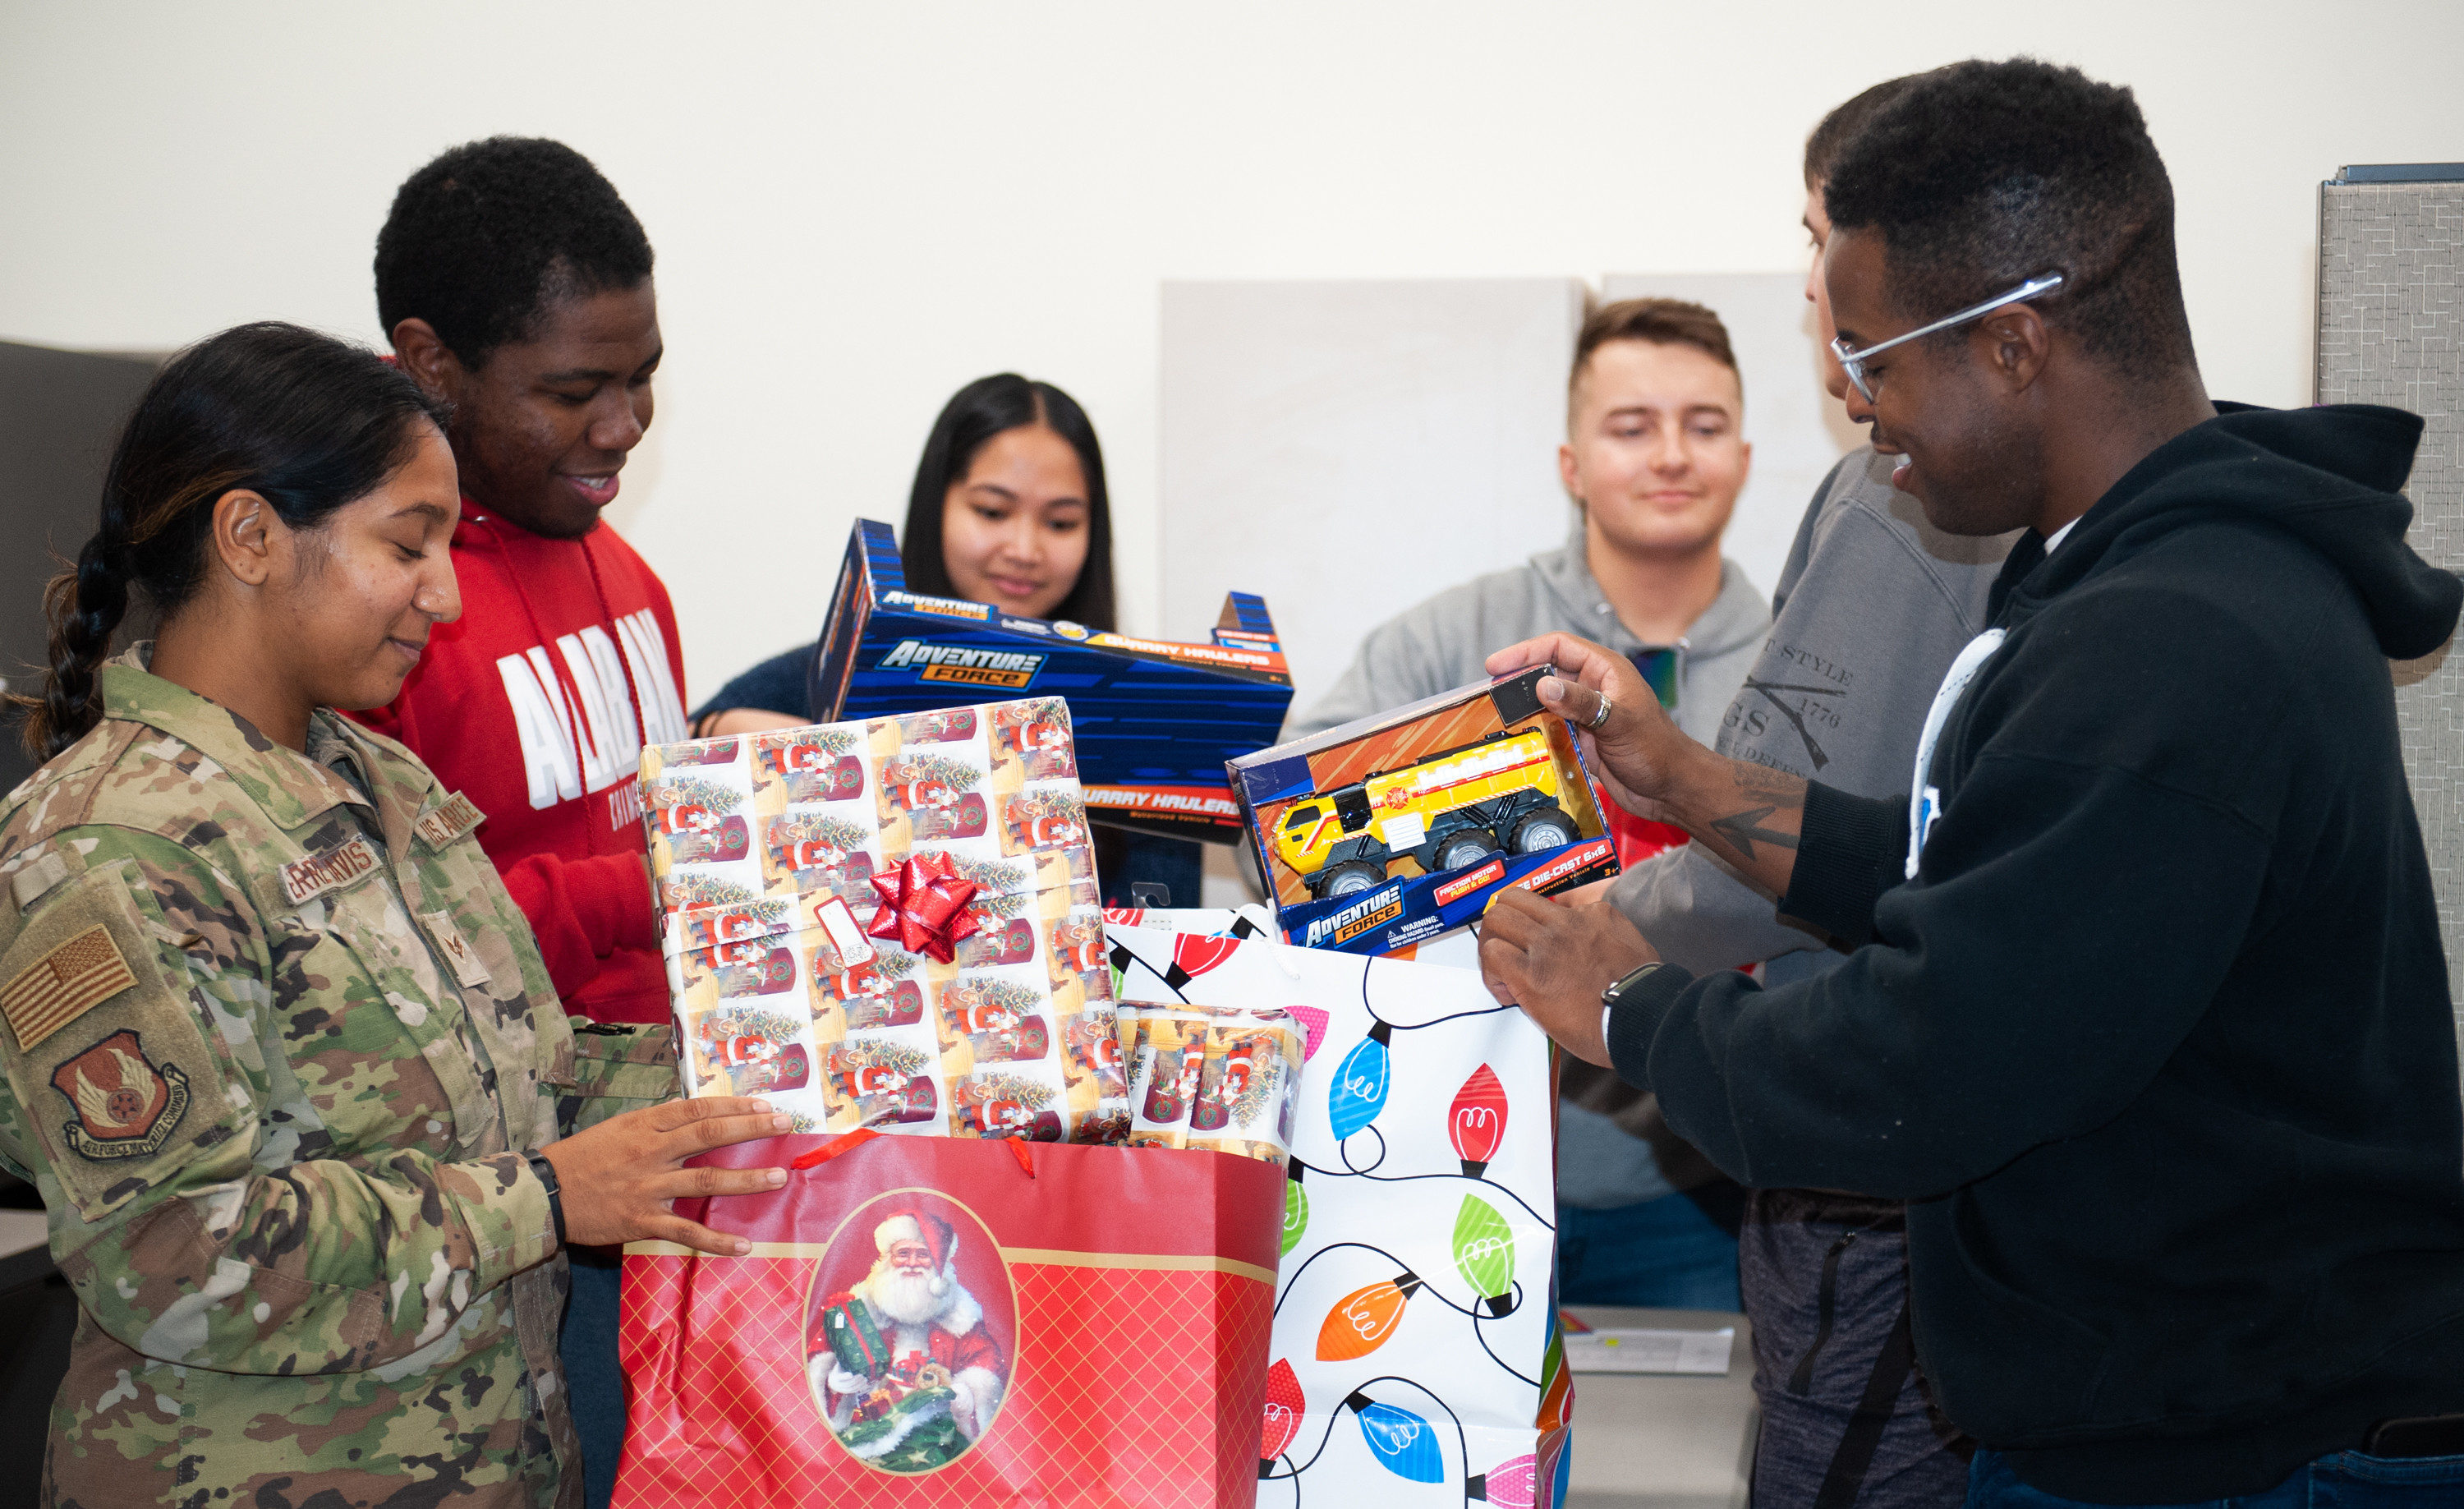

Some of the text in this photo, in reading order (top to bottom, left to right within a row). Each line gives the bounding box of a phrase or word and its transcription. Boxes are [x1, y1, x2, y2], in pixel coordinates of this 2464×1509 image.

[882, 591, 991, 613] ADVENTURE
[880, 640, 1043, 673] ADVENTURE
[1104, 635, 1181, 654] QUARRY
[1184, 646, 1270, 666] HAULERS
[935, 667, 1019, 685] FORCE
[1781, 646, 1853, 687] STYLE
[496, 607, 689, 811] ALABAM
[1800, 699, 1841, 729] 1776
[1081, 789, 1151, 807] UARRY
[1439, 865, 1496, 896] FRICTION MOTOR
[1533, 856, 1582, 886] DIE-CAST
[1569, 867, 1591, 879] Vehicle
[1604, 868, 1617, 876] 3+
[1450, 886, 1470, 898] PUSH
[1478, 875, 1491, 886] GO!
[1307, 886, 1400, 947] ADVENTURE
[1343, 907, 1395, 939] FORCE
[1401, 915, 1439, 932] WARNING:
[99, 1142, 129, 1156] FORCE
[162, 1084, 185, 1125] COMMAND
